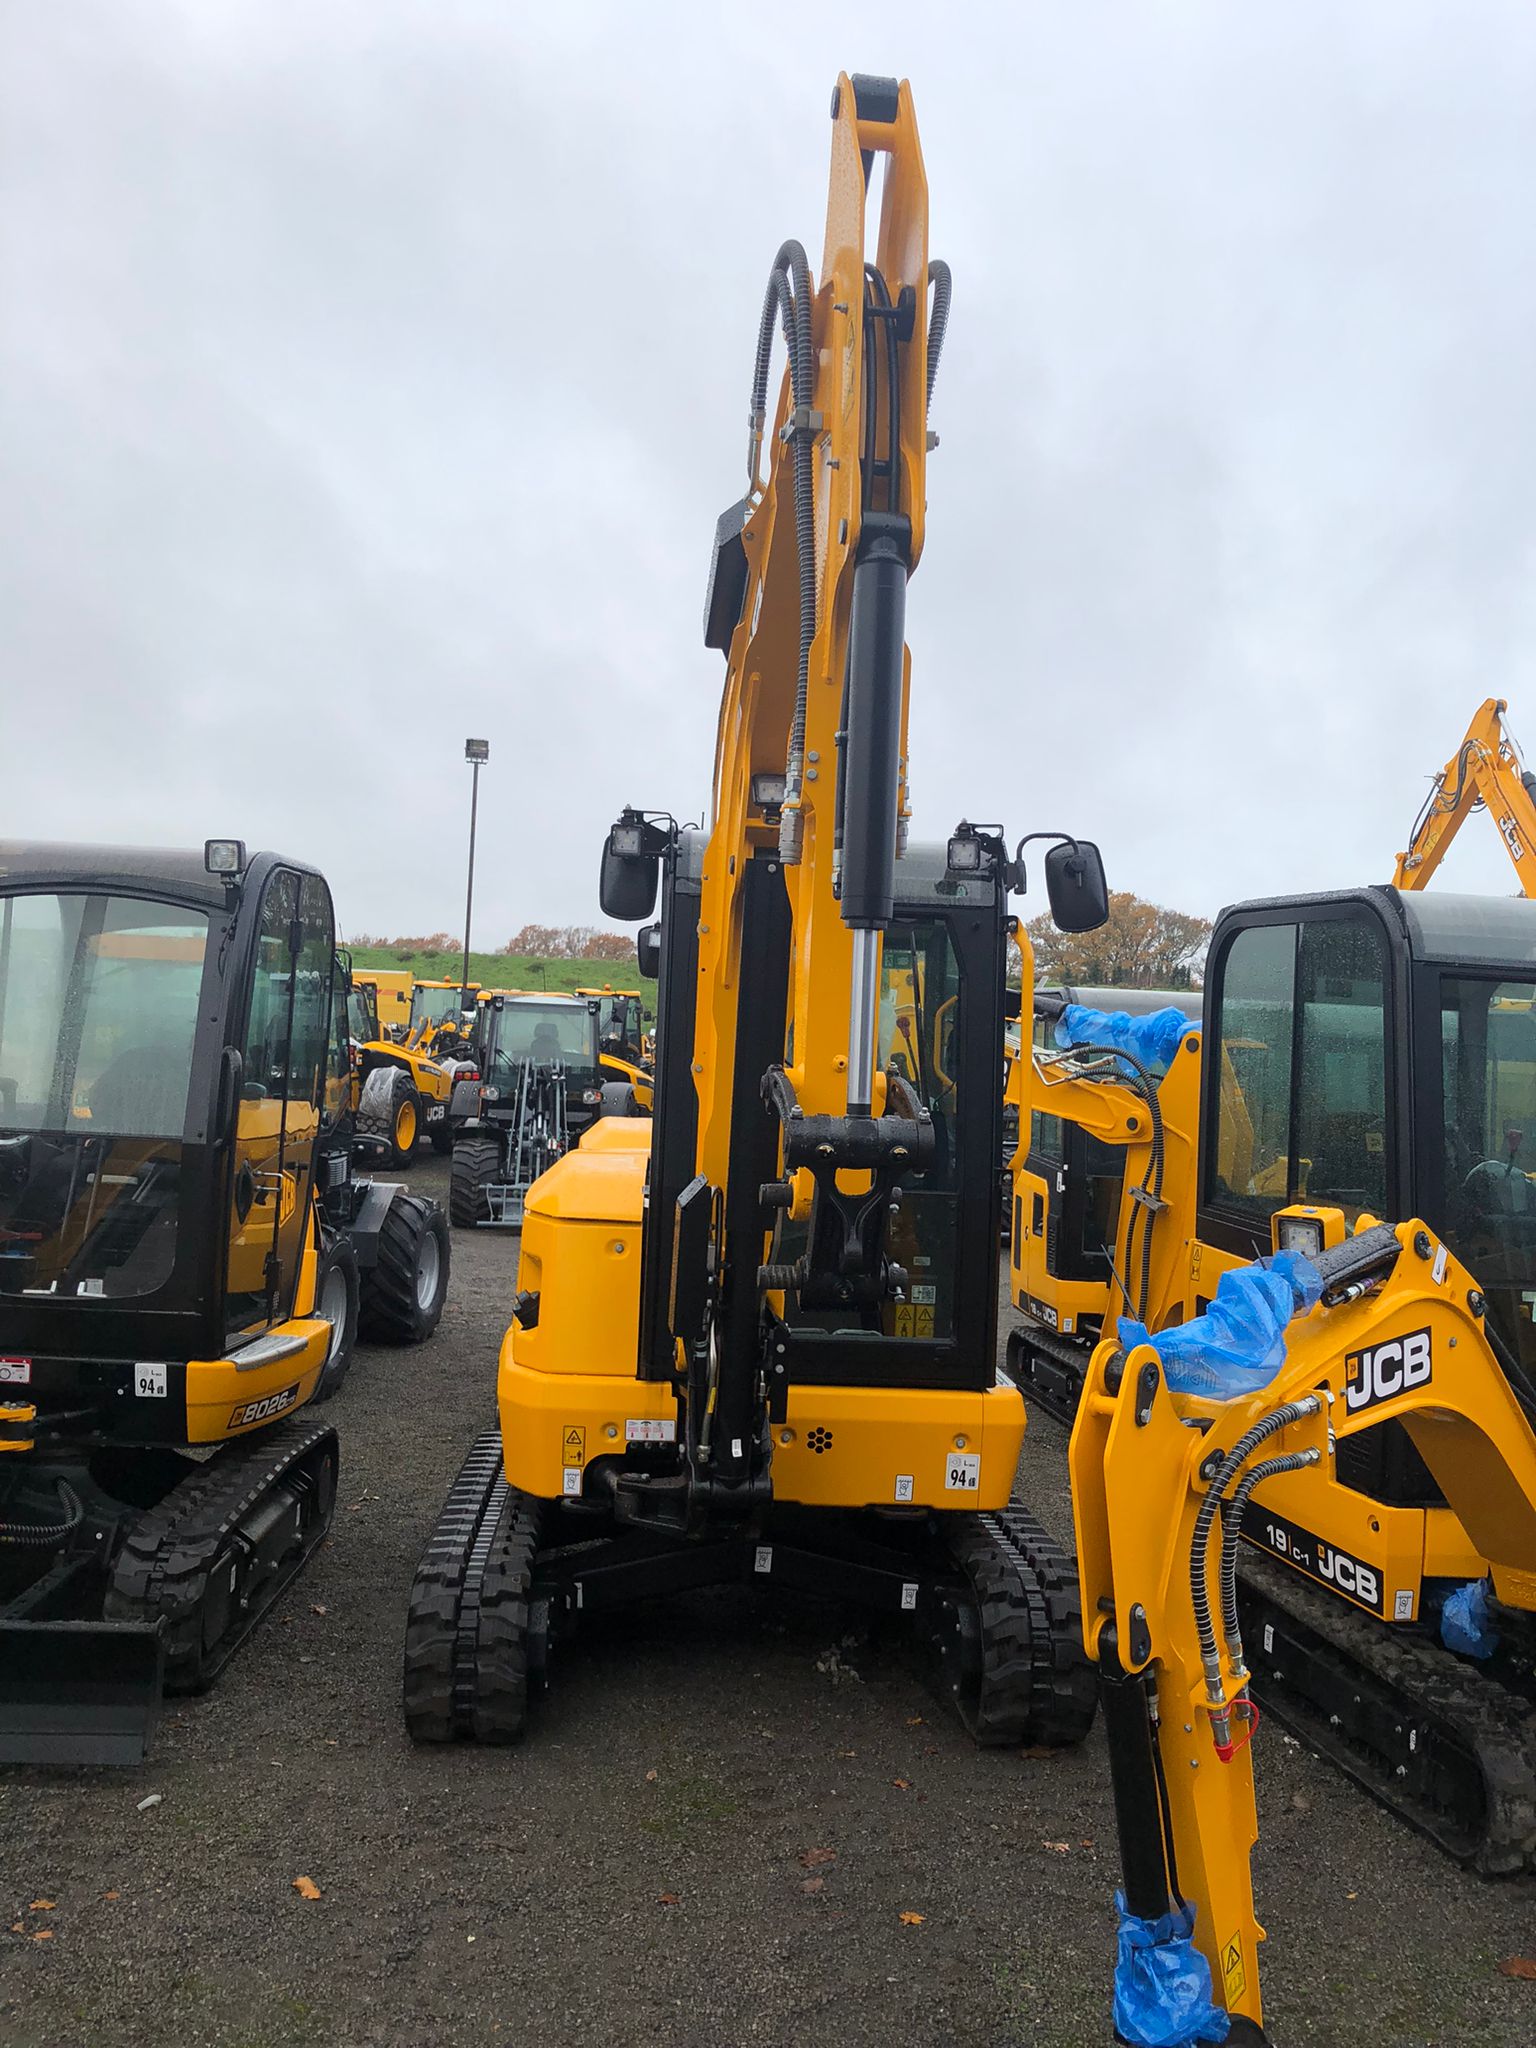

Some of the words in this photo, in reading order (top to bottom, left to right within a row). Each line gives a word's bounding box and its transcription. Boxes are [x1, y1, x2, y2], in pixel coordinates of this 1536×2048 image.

[1499, 815, 1524, 861] JCB
[427, 1105, 445, 1122] JCB
[139, 1378, 155, 1394] 94
[1347, 1333, 1431, 1408] JCB
[241, 1390, 289, 1424] 8026
[950, 1469, 967, 1487] 94
[1266, 1524, 1287, 1552] 19
[1318, 1548, 1379, 1605] JCB
